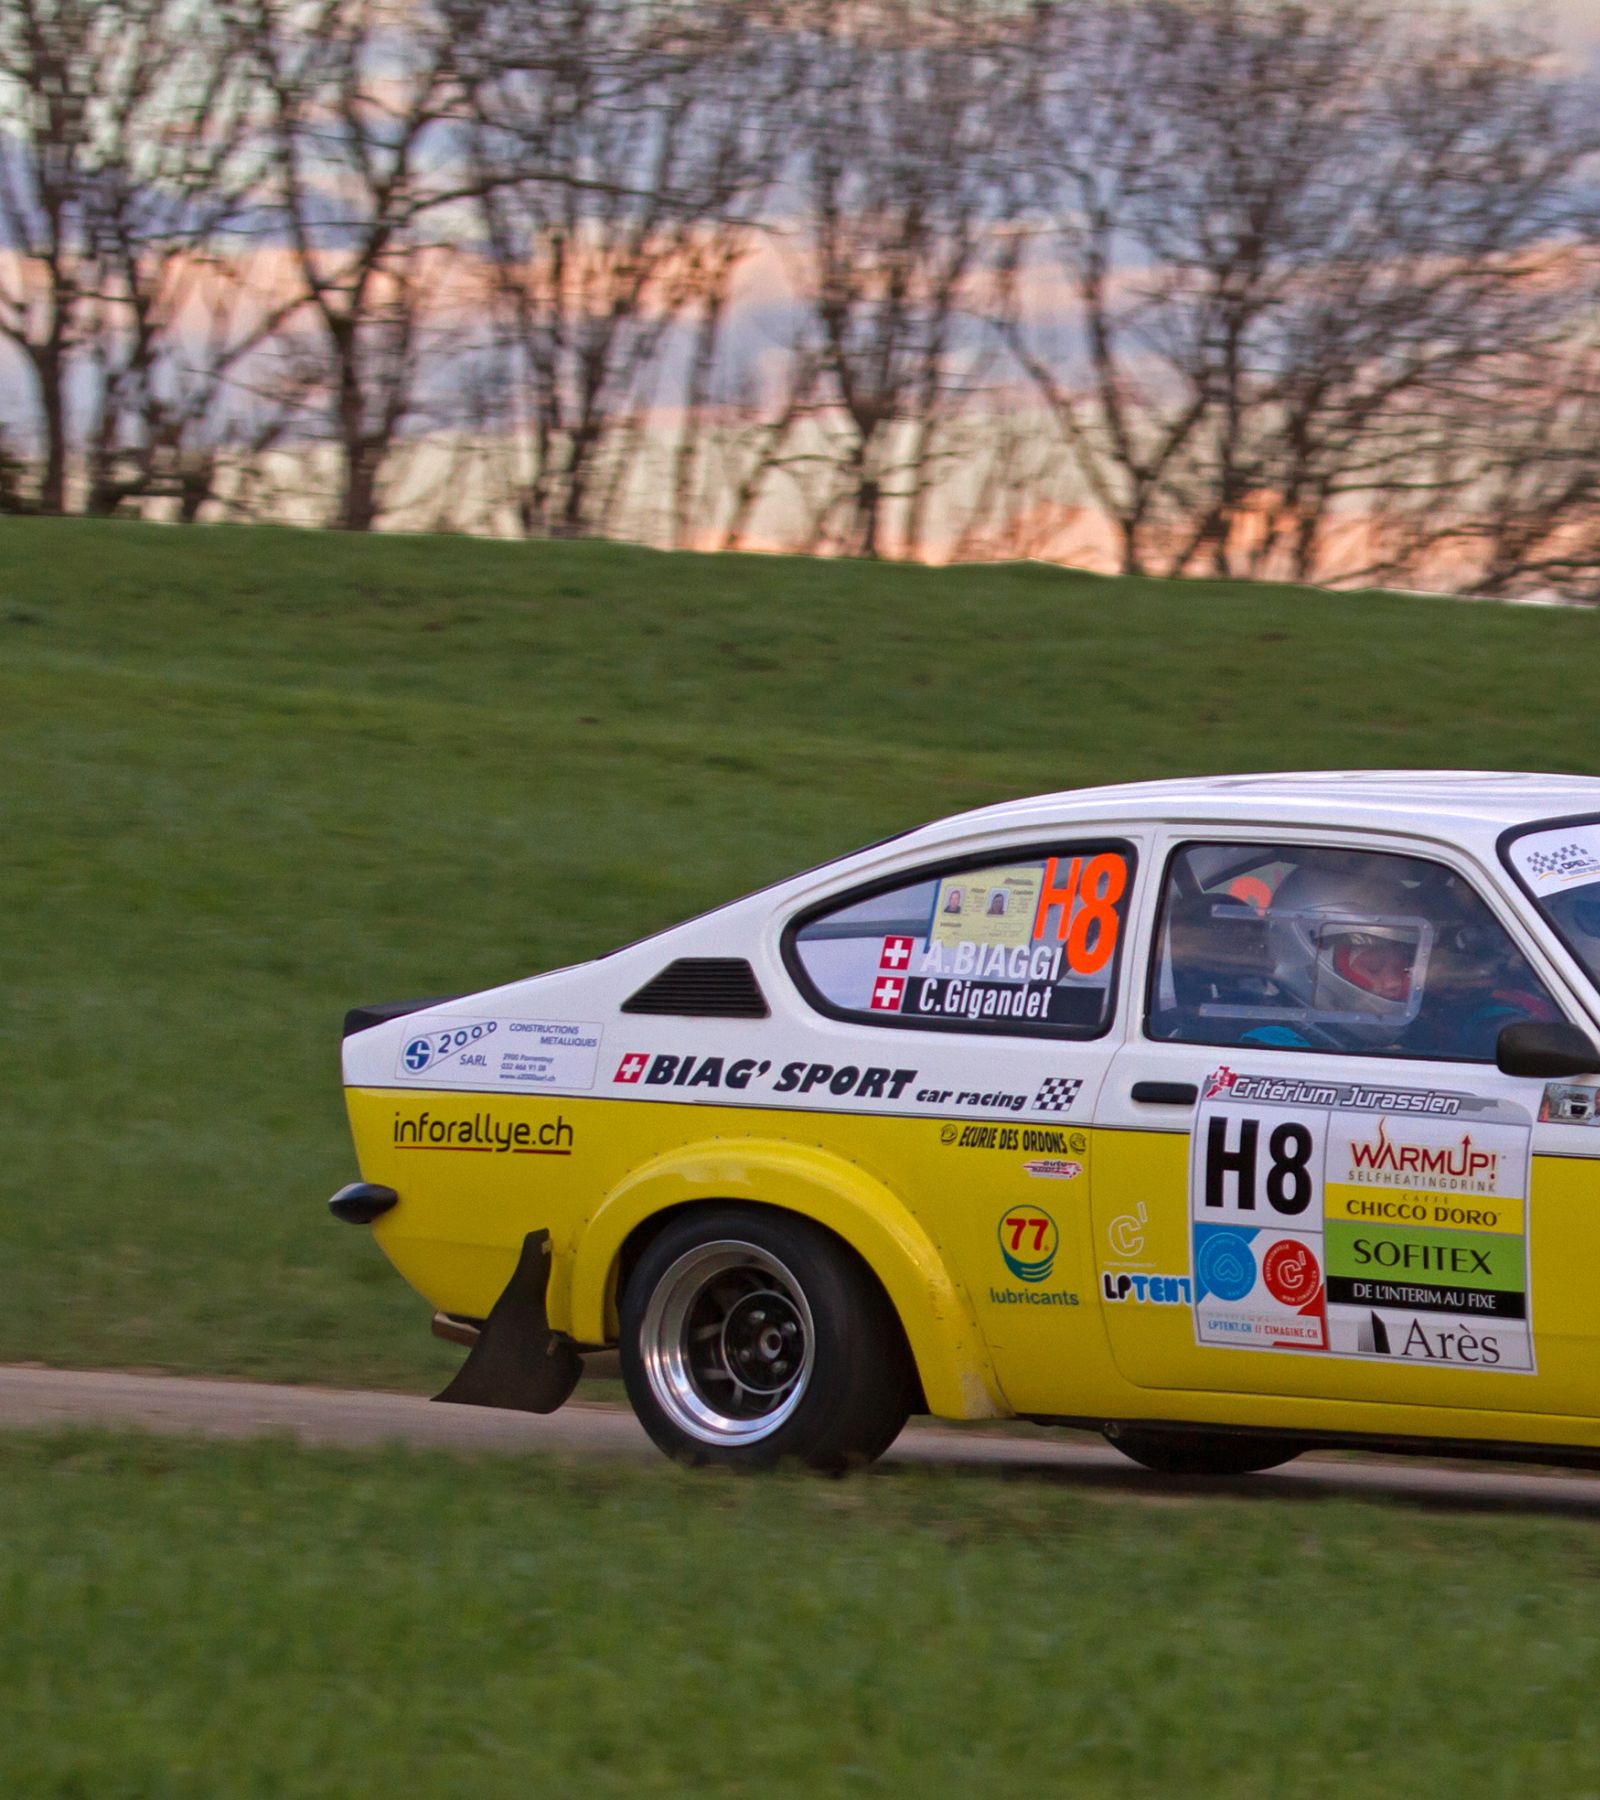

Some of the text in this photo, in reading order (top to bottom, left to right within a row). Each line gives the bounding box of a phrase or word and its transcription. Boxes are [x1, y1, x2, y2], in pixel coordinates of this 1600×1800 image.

[1033, 853, 1128, 975] H8
[919, 939, 1064, 981] A.BIAGGI
[918, 977, 1053, 1019] C.Gigandet
[509, 1022, 579, 1035] CONSTRUCTIONS
[540, 1036, 597, 1048] METALLIQUES
[459, 1053, 488, 1067] SARL
[773, 1061, 918, 1100] SPORT
[916, 1087, 954, 1105] car
[954, 1089, 1028, 1111] racing
[1230, 1076, 1461, 1115] Critérium Jurassien
[393, 1111, 574, 1153] inforallye.ch
[958, 1125, 1069, 1154] ECURIE DES ORDONS
[1205, 1115, 1313, 1215] H8
[1348, 1170, 1496, 1193] SELFHEATINGDRINK
[1346, 1199, 1498, 1228] CHICCO D'ORO
[1005, 1217, 1050, 1252] 77
[1352, 1238, 1494, 1276] SOFITEX
[989, 1286, 1080, 1306] lubricants
[1353, 1282, 1497, 1310] DE L'INTERIM AU FIXE
[1401, 1317, 1500, 1364] Arès
